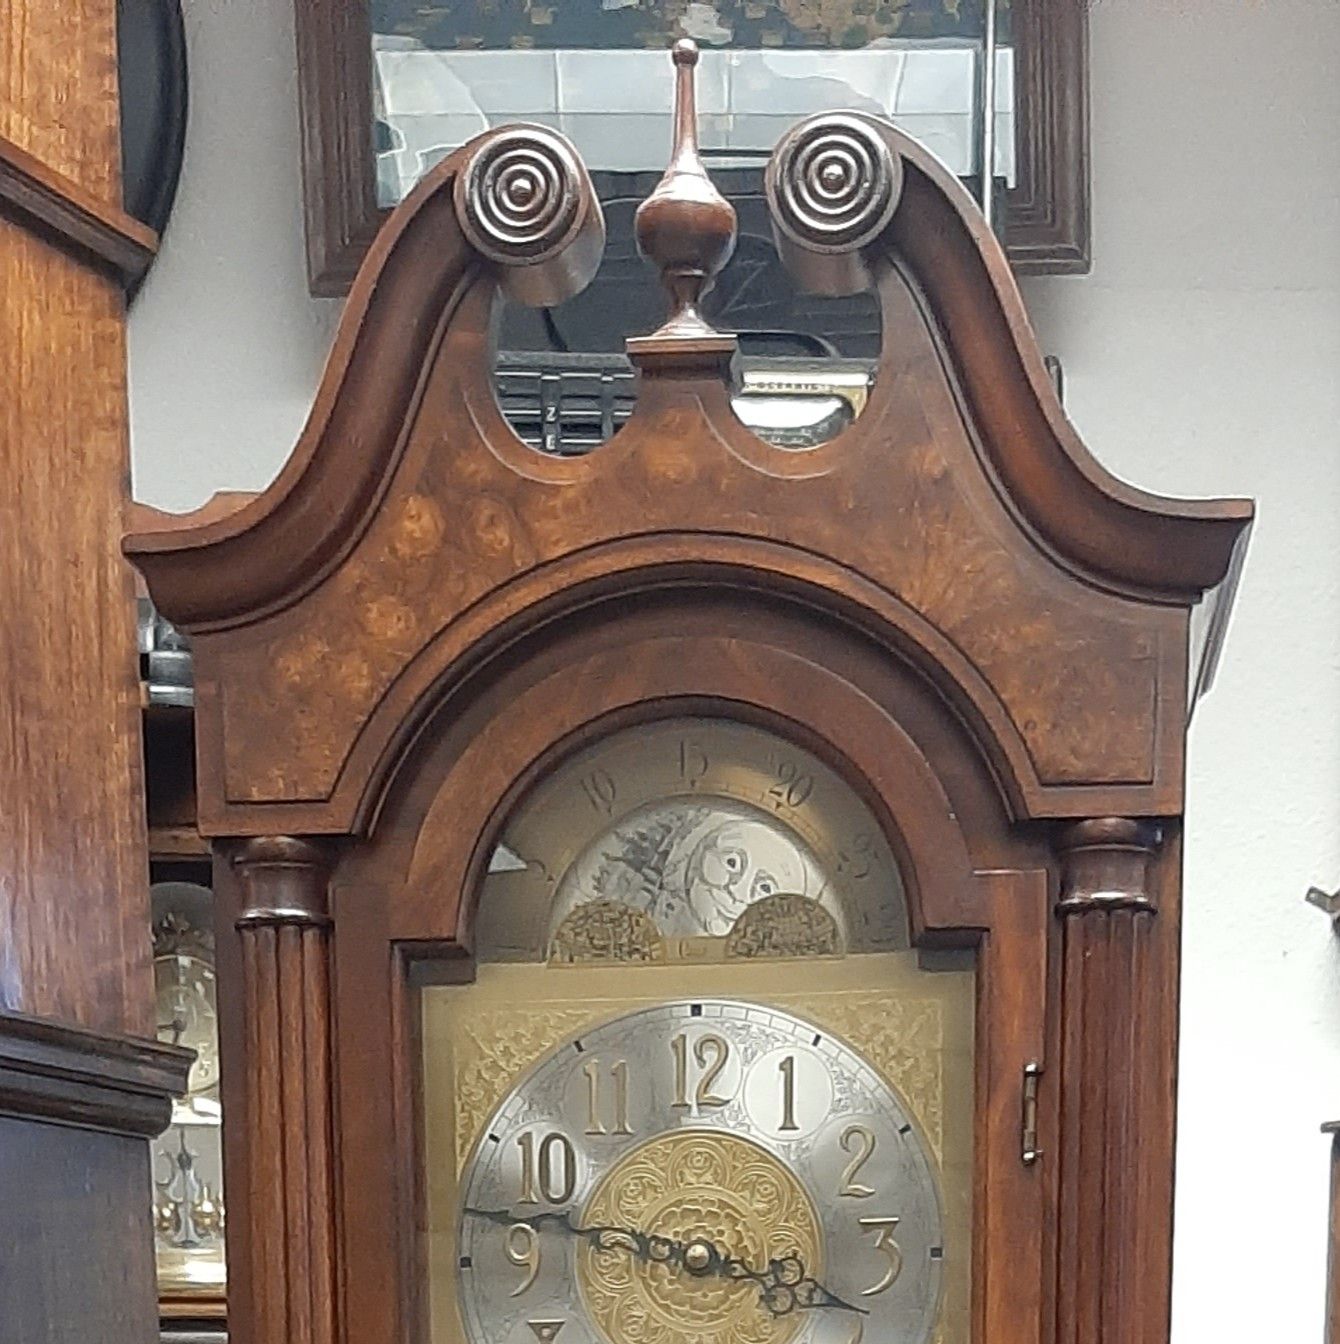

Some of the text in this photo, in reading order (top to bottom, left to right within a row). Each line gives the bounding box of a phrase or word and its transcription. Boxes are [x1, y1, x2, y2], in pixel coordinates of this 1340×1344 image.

[679, 739, 709, 778] 15
[769, 762, 814, 807] 20
[583, 1059, 635, 1136] 11
[670, 1033, 732, 1109] 12
[777, 1055, 801, 1132] 1
[516, 1130, 577, 1207] 10
[838, 1125, 877, 1198] 2
[504, 1223, 541, 1298] 9
[858, 1217, 902, 1297] 3
